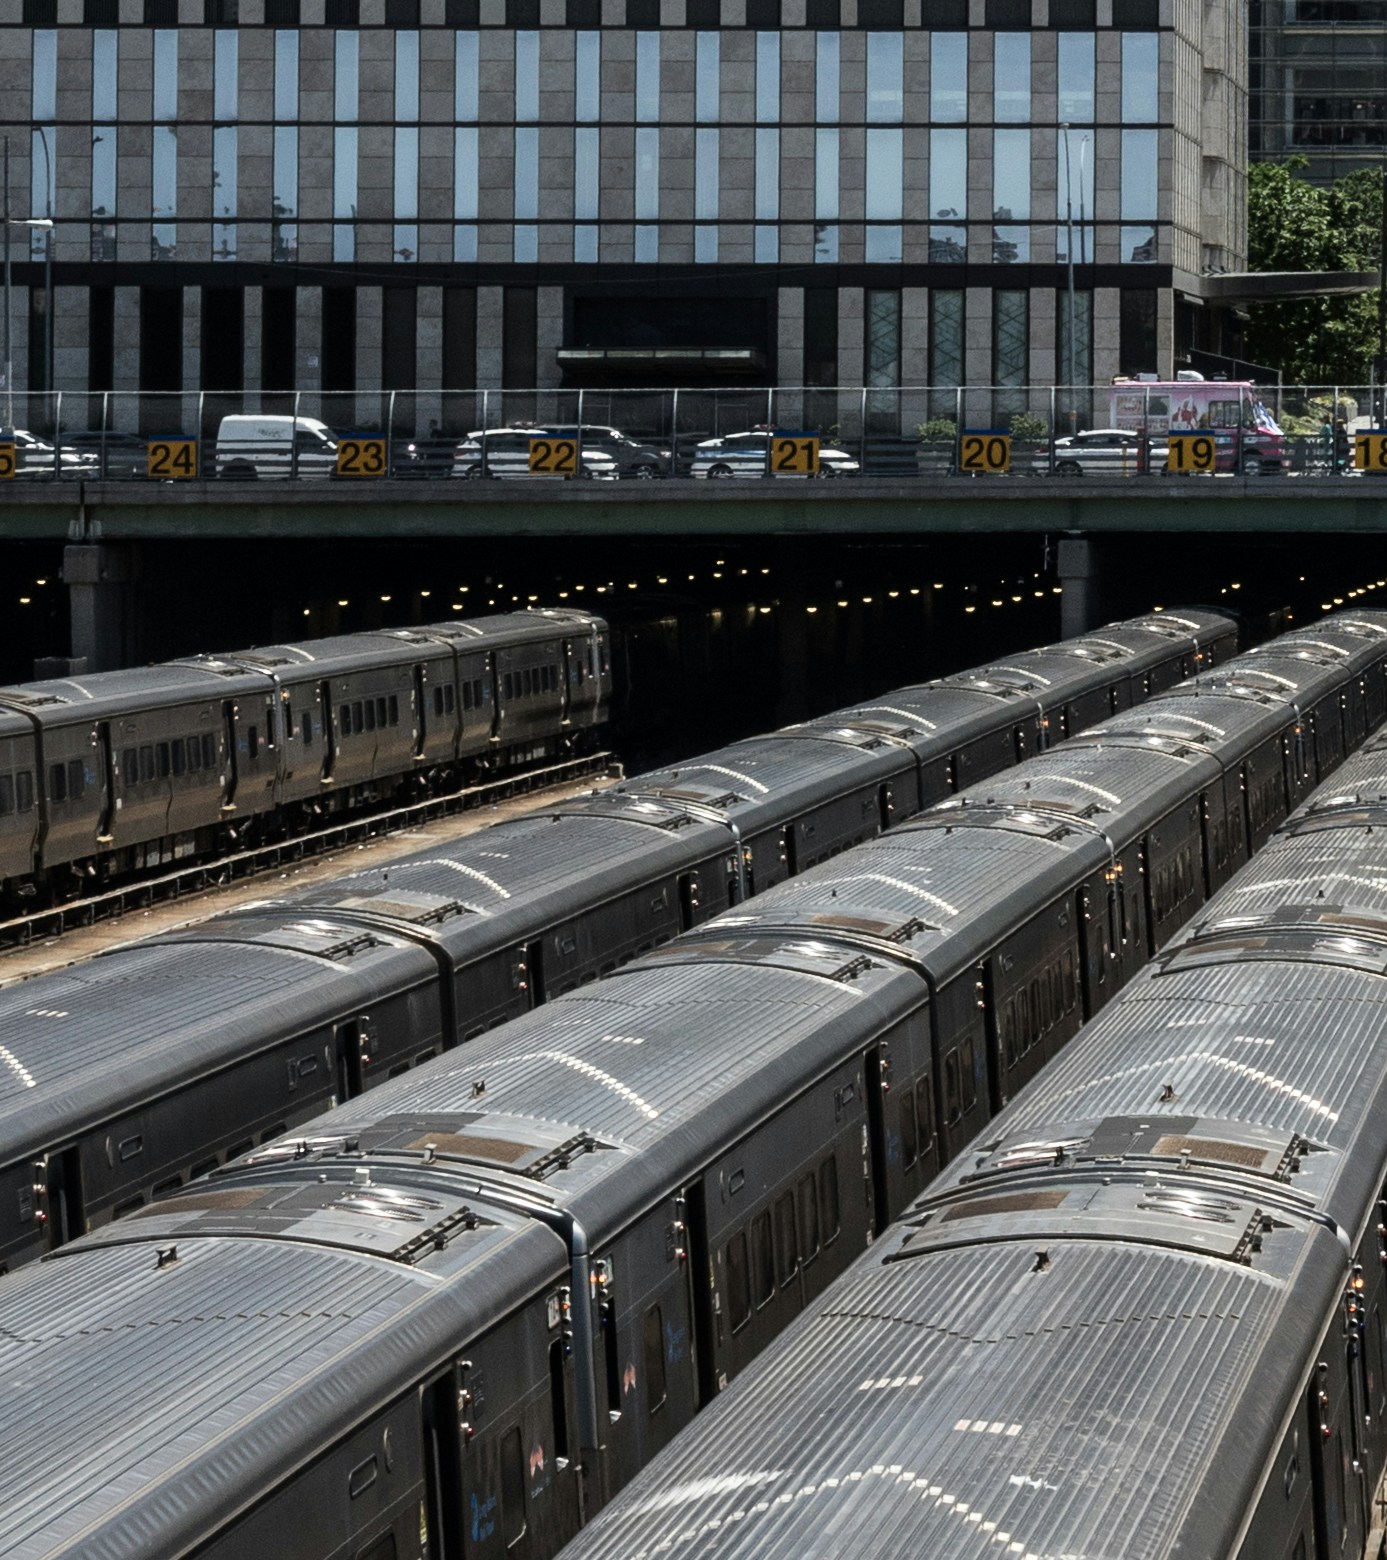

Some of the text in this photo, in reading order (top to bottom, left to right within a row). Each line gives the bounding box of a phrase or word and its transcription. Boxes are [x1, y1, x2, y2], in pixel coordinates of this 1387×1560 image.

[150, 444, 194, 475] 24
[340, 442, 383, 473] 23
[531, 441, 575, 472] 22
[776, 441, 818, 471] 21
[963, 437, 1008, 469] 20
[1170, 438, 1213, 469] 19
